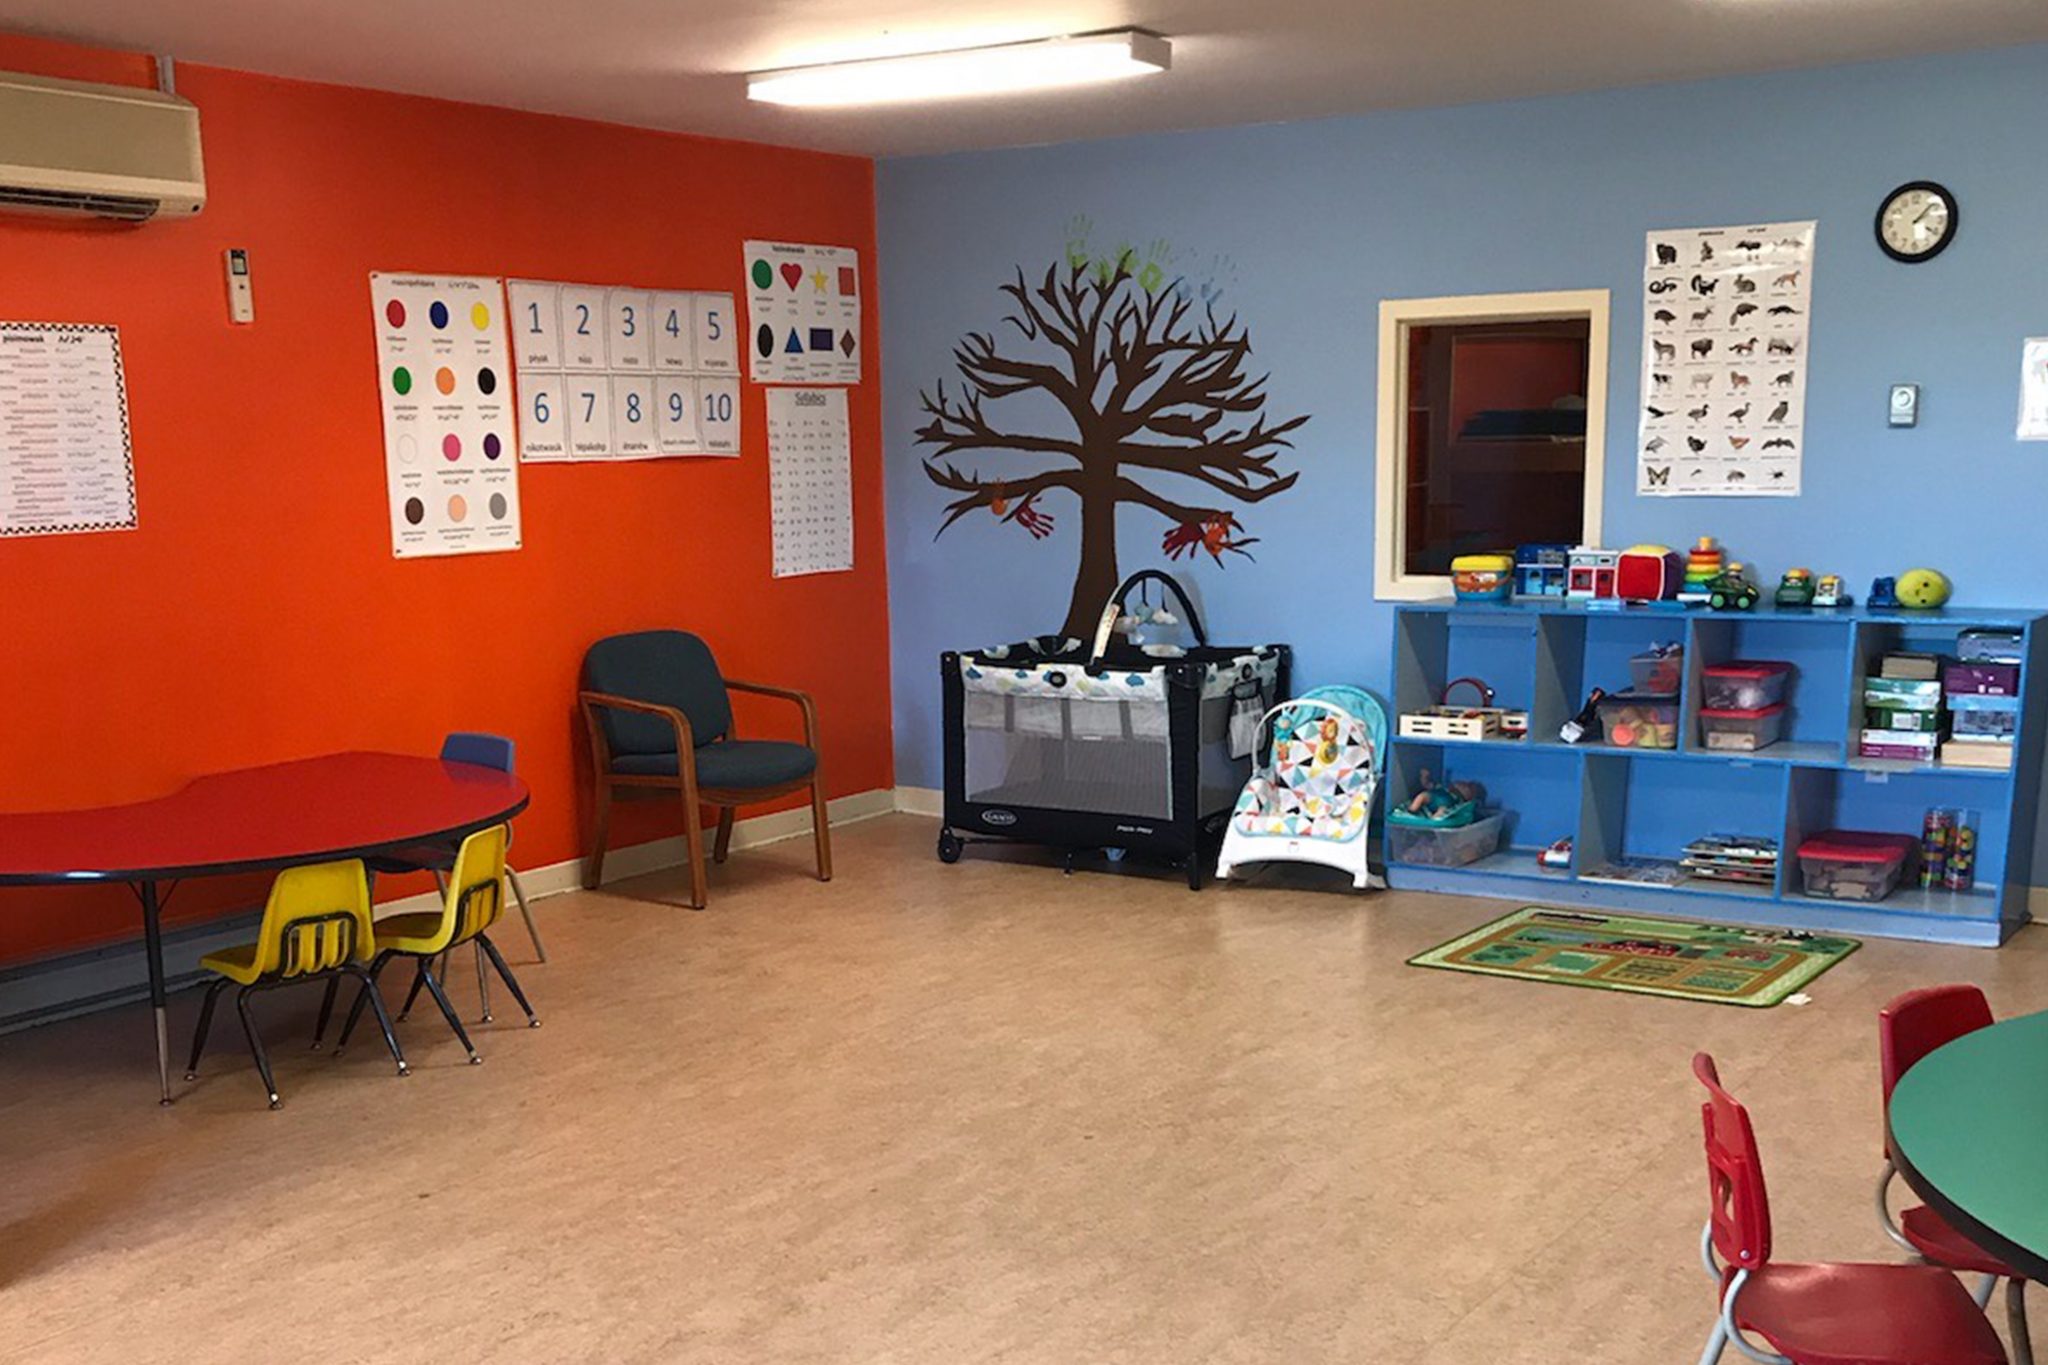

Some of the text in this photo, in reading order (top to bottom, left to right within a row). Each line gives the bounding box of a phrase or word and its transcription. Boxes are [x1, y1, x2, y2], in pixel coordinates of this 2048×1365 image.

[528, 302, 721, 340] 1 2 3 4 5
[534, 392, 550, 423] 6
[581, 393, 595, 423] 7
[626, 393, 641, 423] 8
[668, 392, 683, 422] 9
[705, 393, 732, 422] 10
